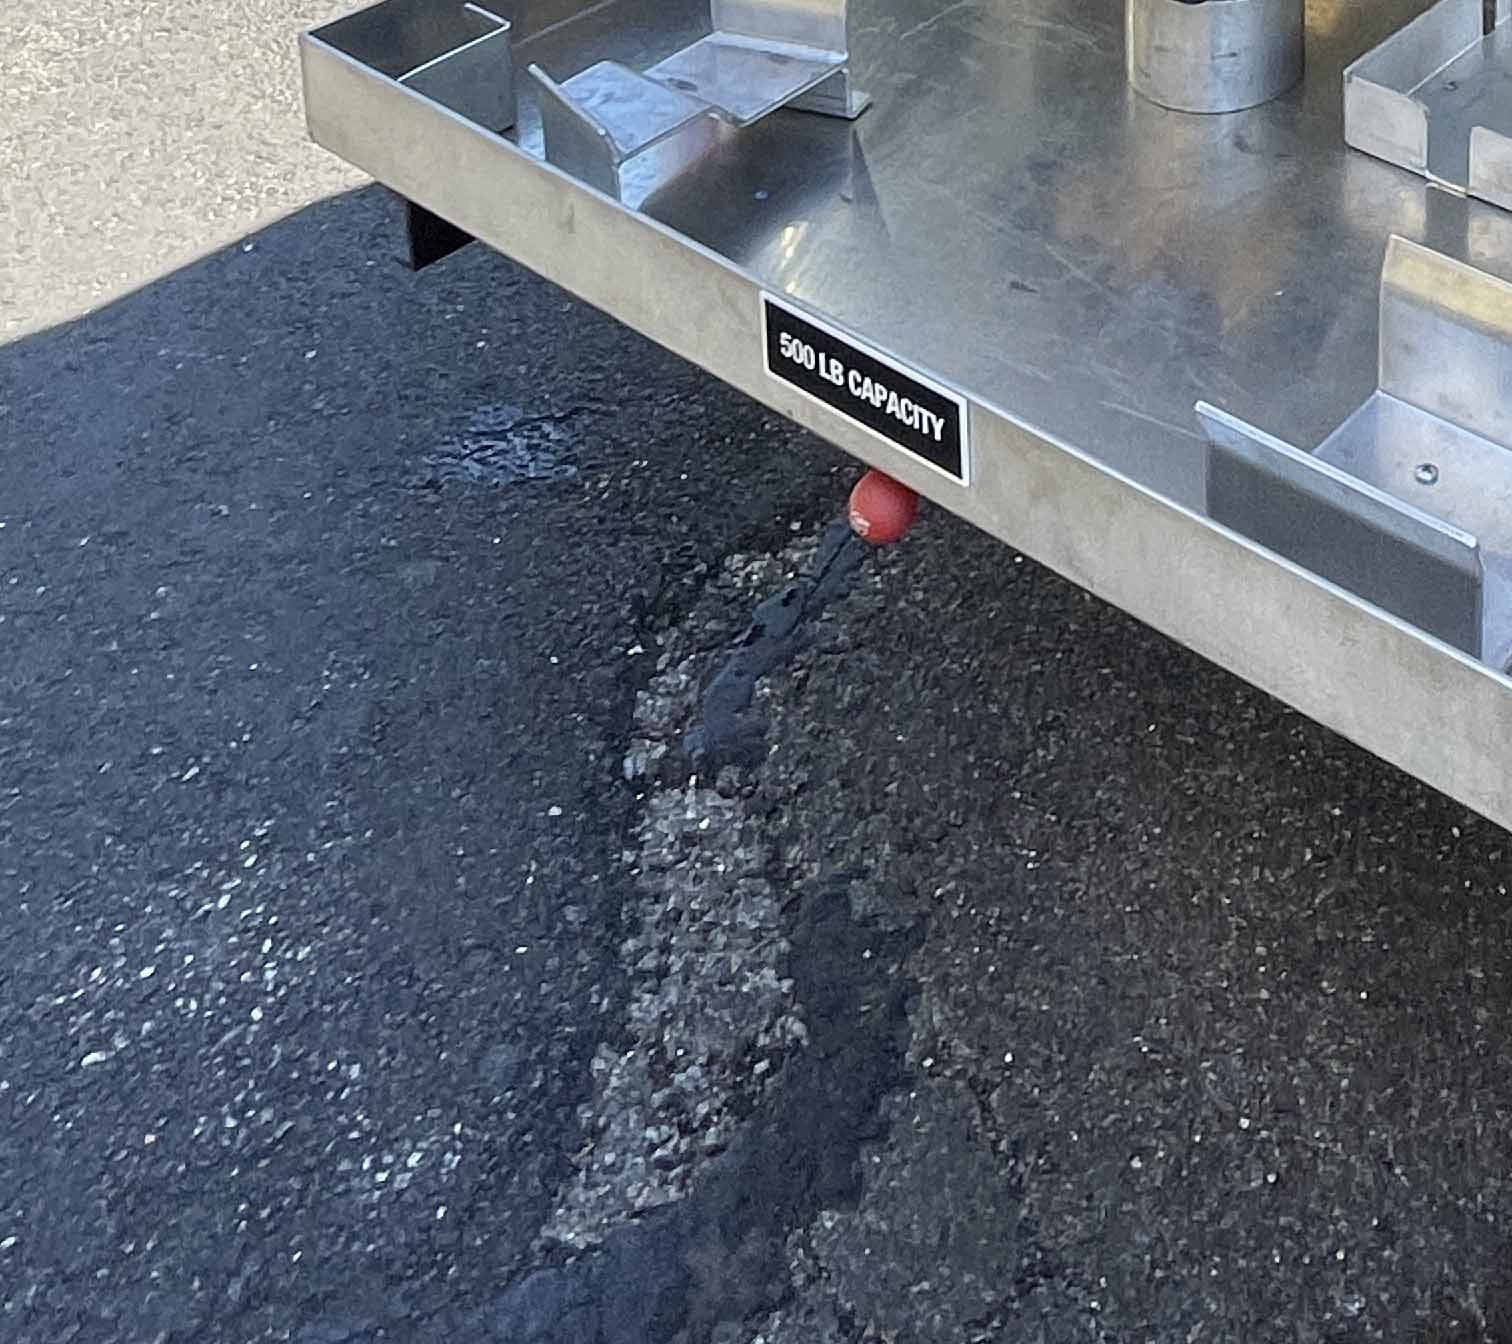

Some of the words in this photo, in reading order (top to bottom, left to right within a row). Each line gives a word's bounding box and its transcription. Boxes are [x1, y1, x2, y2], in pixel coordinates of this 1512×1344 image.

[779, 331, 815, 371] 500
[818, 352, 844, 387] LB
[848, 369, 946, 442] CAPACITY
